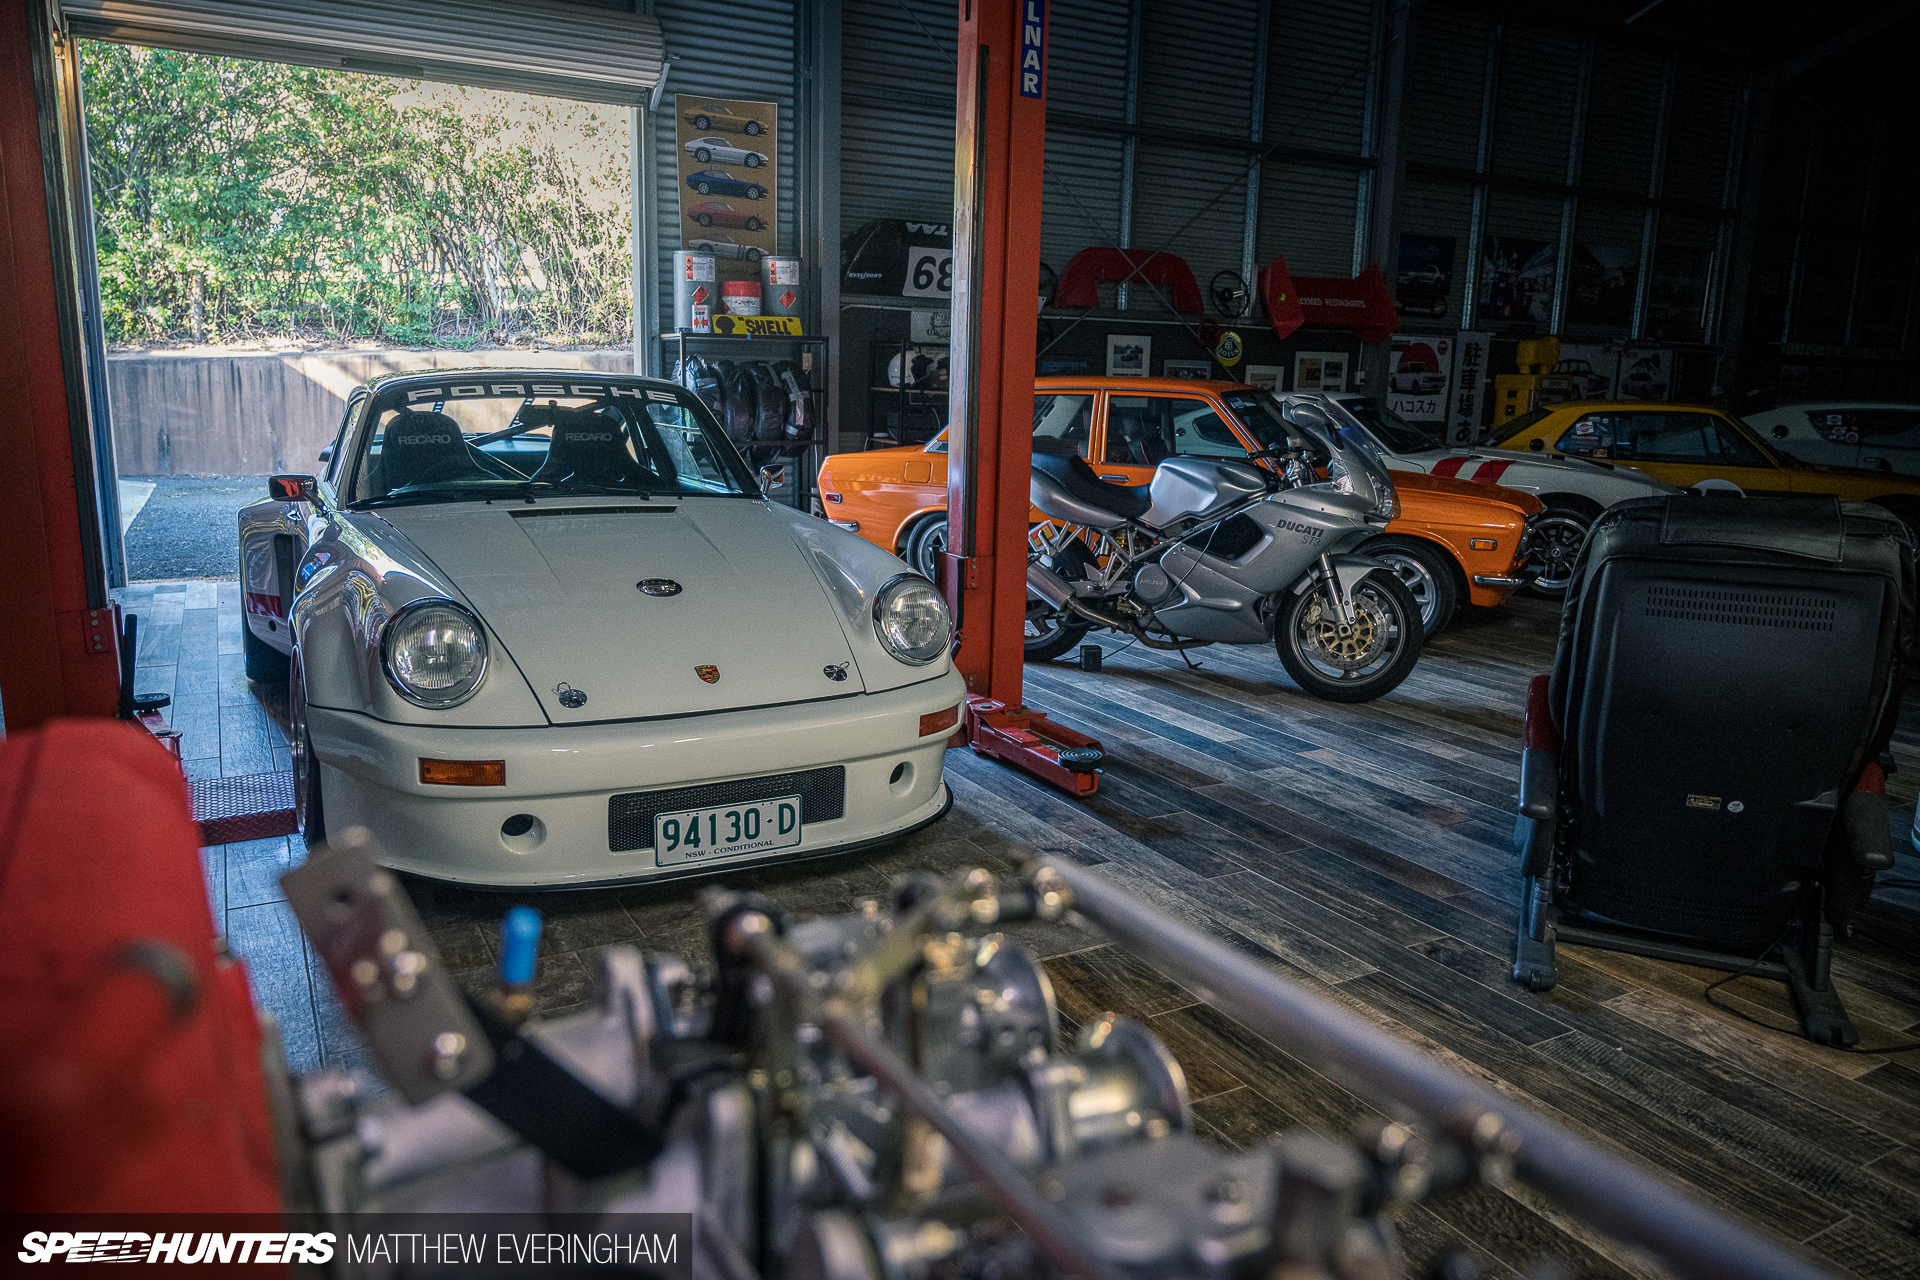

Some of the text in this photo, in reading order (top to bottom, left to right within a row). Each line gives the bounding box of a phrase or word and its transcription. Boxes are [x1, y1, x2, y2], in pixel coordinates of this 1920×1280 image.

[1218, 348, 1240, 357] LOTUS
[407, 384, 679, 404] PORSCHE
[1393, 400, 1436, 414] ハコスカ
[398, 434, 451, 445] RECARO
[565, 432, 613, 443] RECARO
[1276, 519, 1325, 538] DUCATI
[1301, 534, 1321, 547] ST3
[685, 850, 706, 859] NSW
[713, 839, 775, 855] CONDITIONAL
